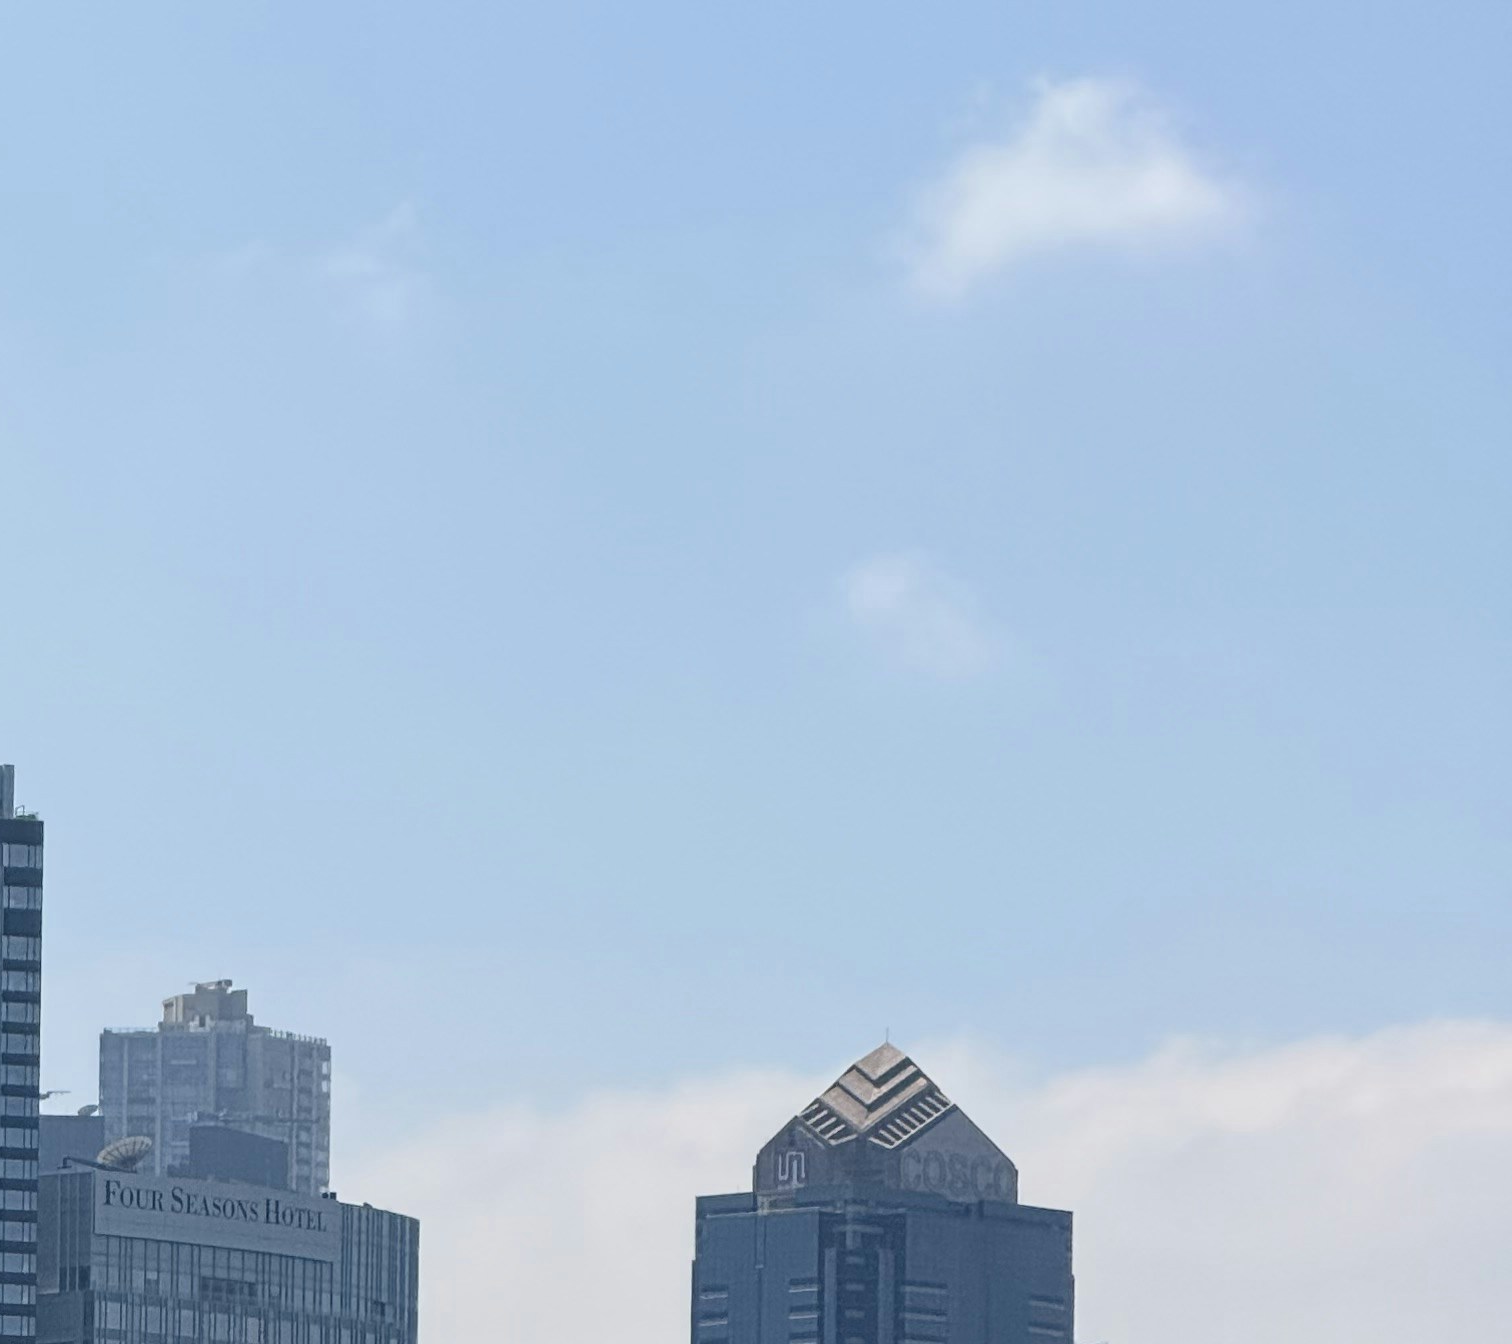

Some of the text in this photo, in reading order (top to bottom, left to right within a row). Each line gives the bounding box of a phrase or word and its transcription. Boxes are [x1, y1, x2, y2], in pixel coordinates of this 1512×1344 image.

[900, 1148, 1013, 1199] COSCO
[103, 1179, 327, 1232] FOUR SEASONS HOTEL
